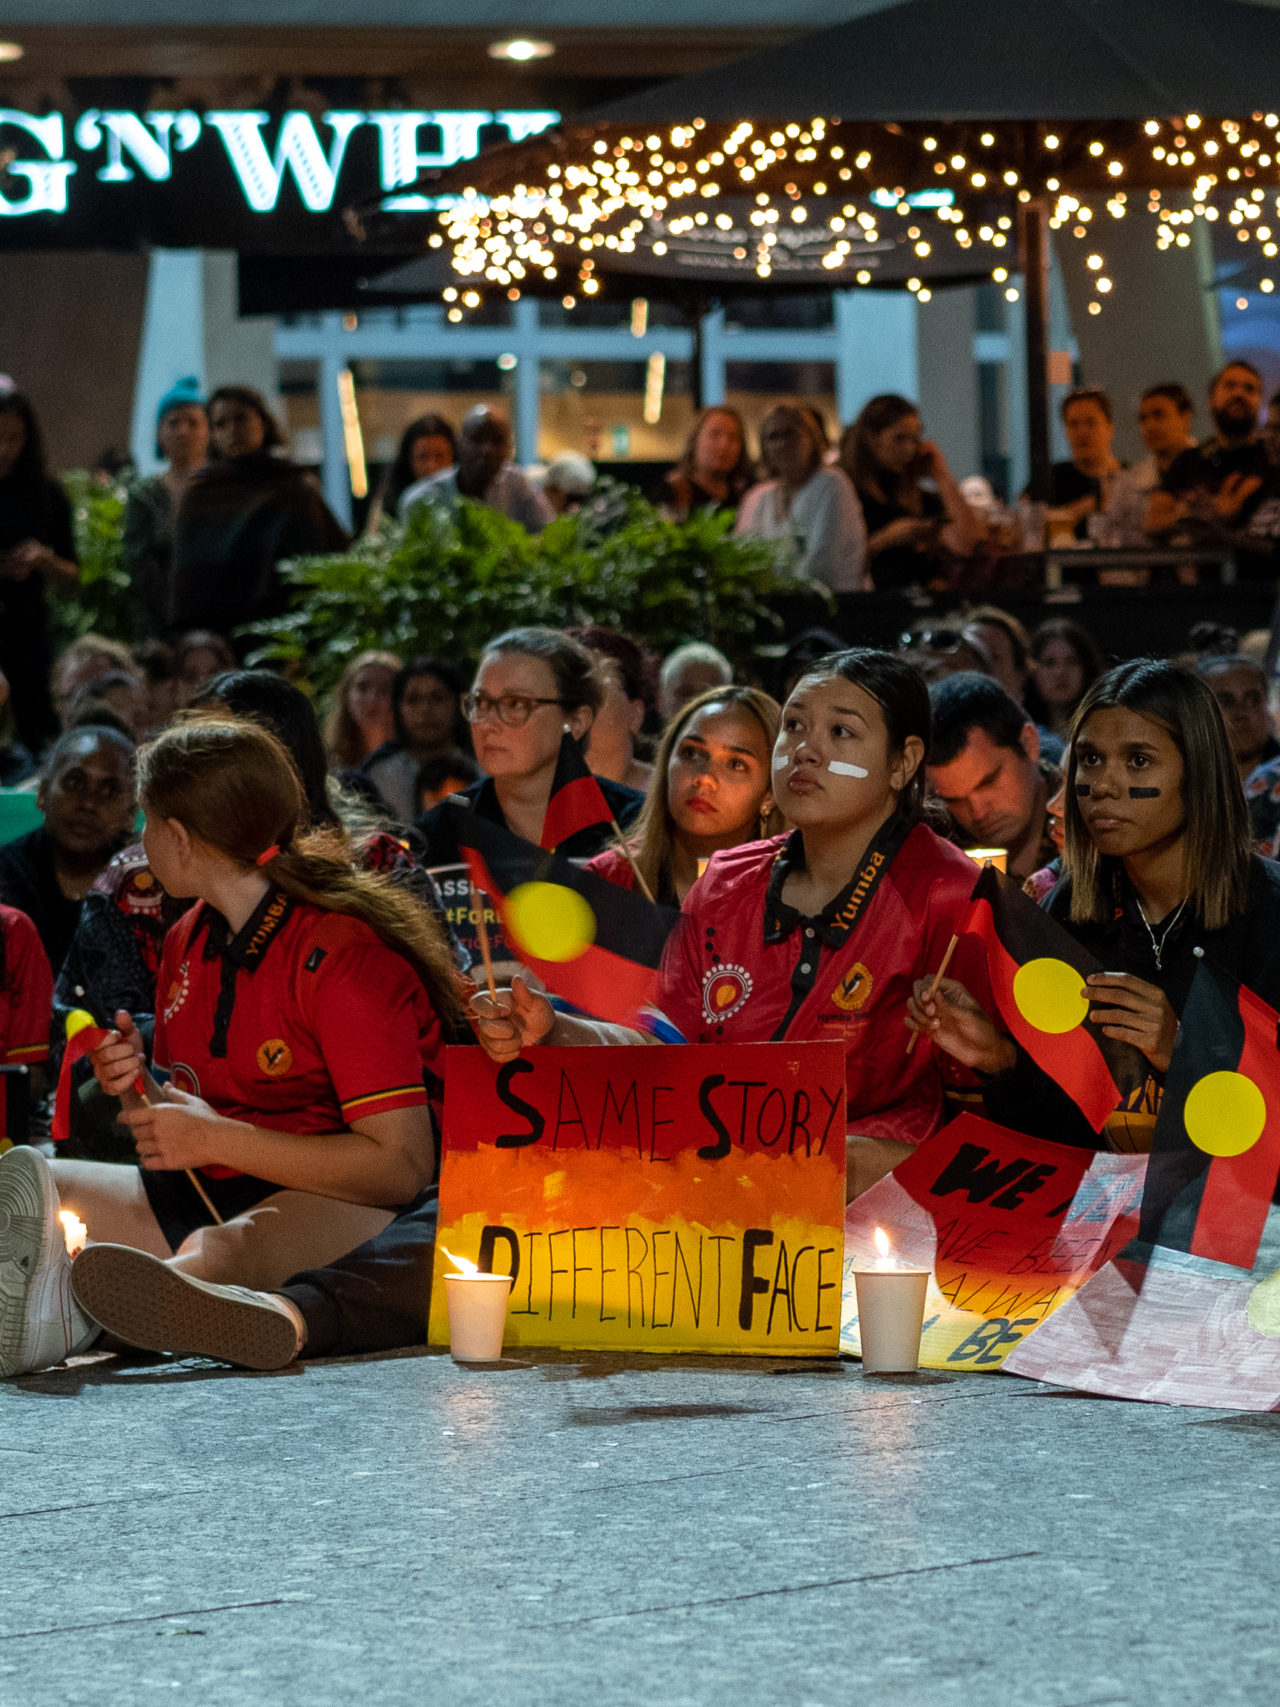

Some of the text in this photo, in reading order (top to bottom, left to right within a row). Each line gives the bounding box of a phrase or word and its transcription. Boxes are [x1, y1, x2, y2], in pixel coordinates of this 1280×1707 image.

[830, 851, 886, 931] Yumba
[495, 1058, 843, 1162] SAME STORY
[930, 1143, 1059, 1210] WE
[477, 1225, 837, 1335] DIFFERENT FACE
[938, 1272, 1062, 1319] ALWA
[946, 1317, 1039, 1364] BE
